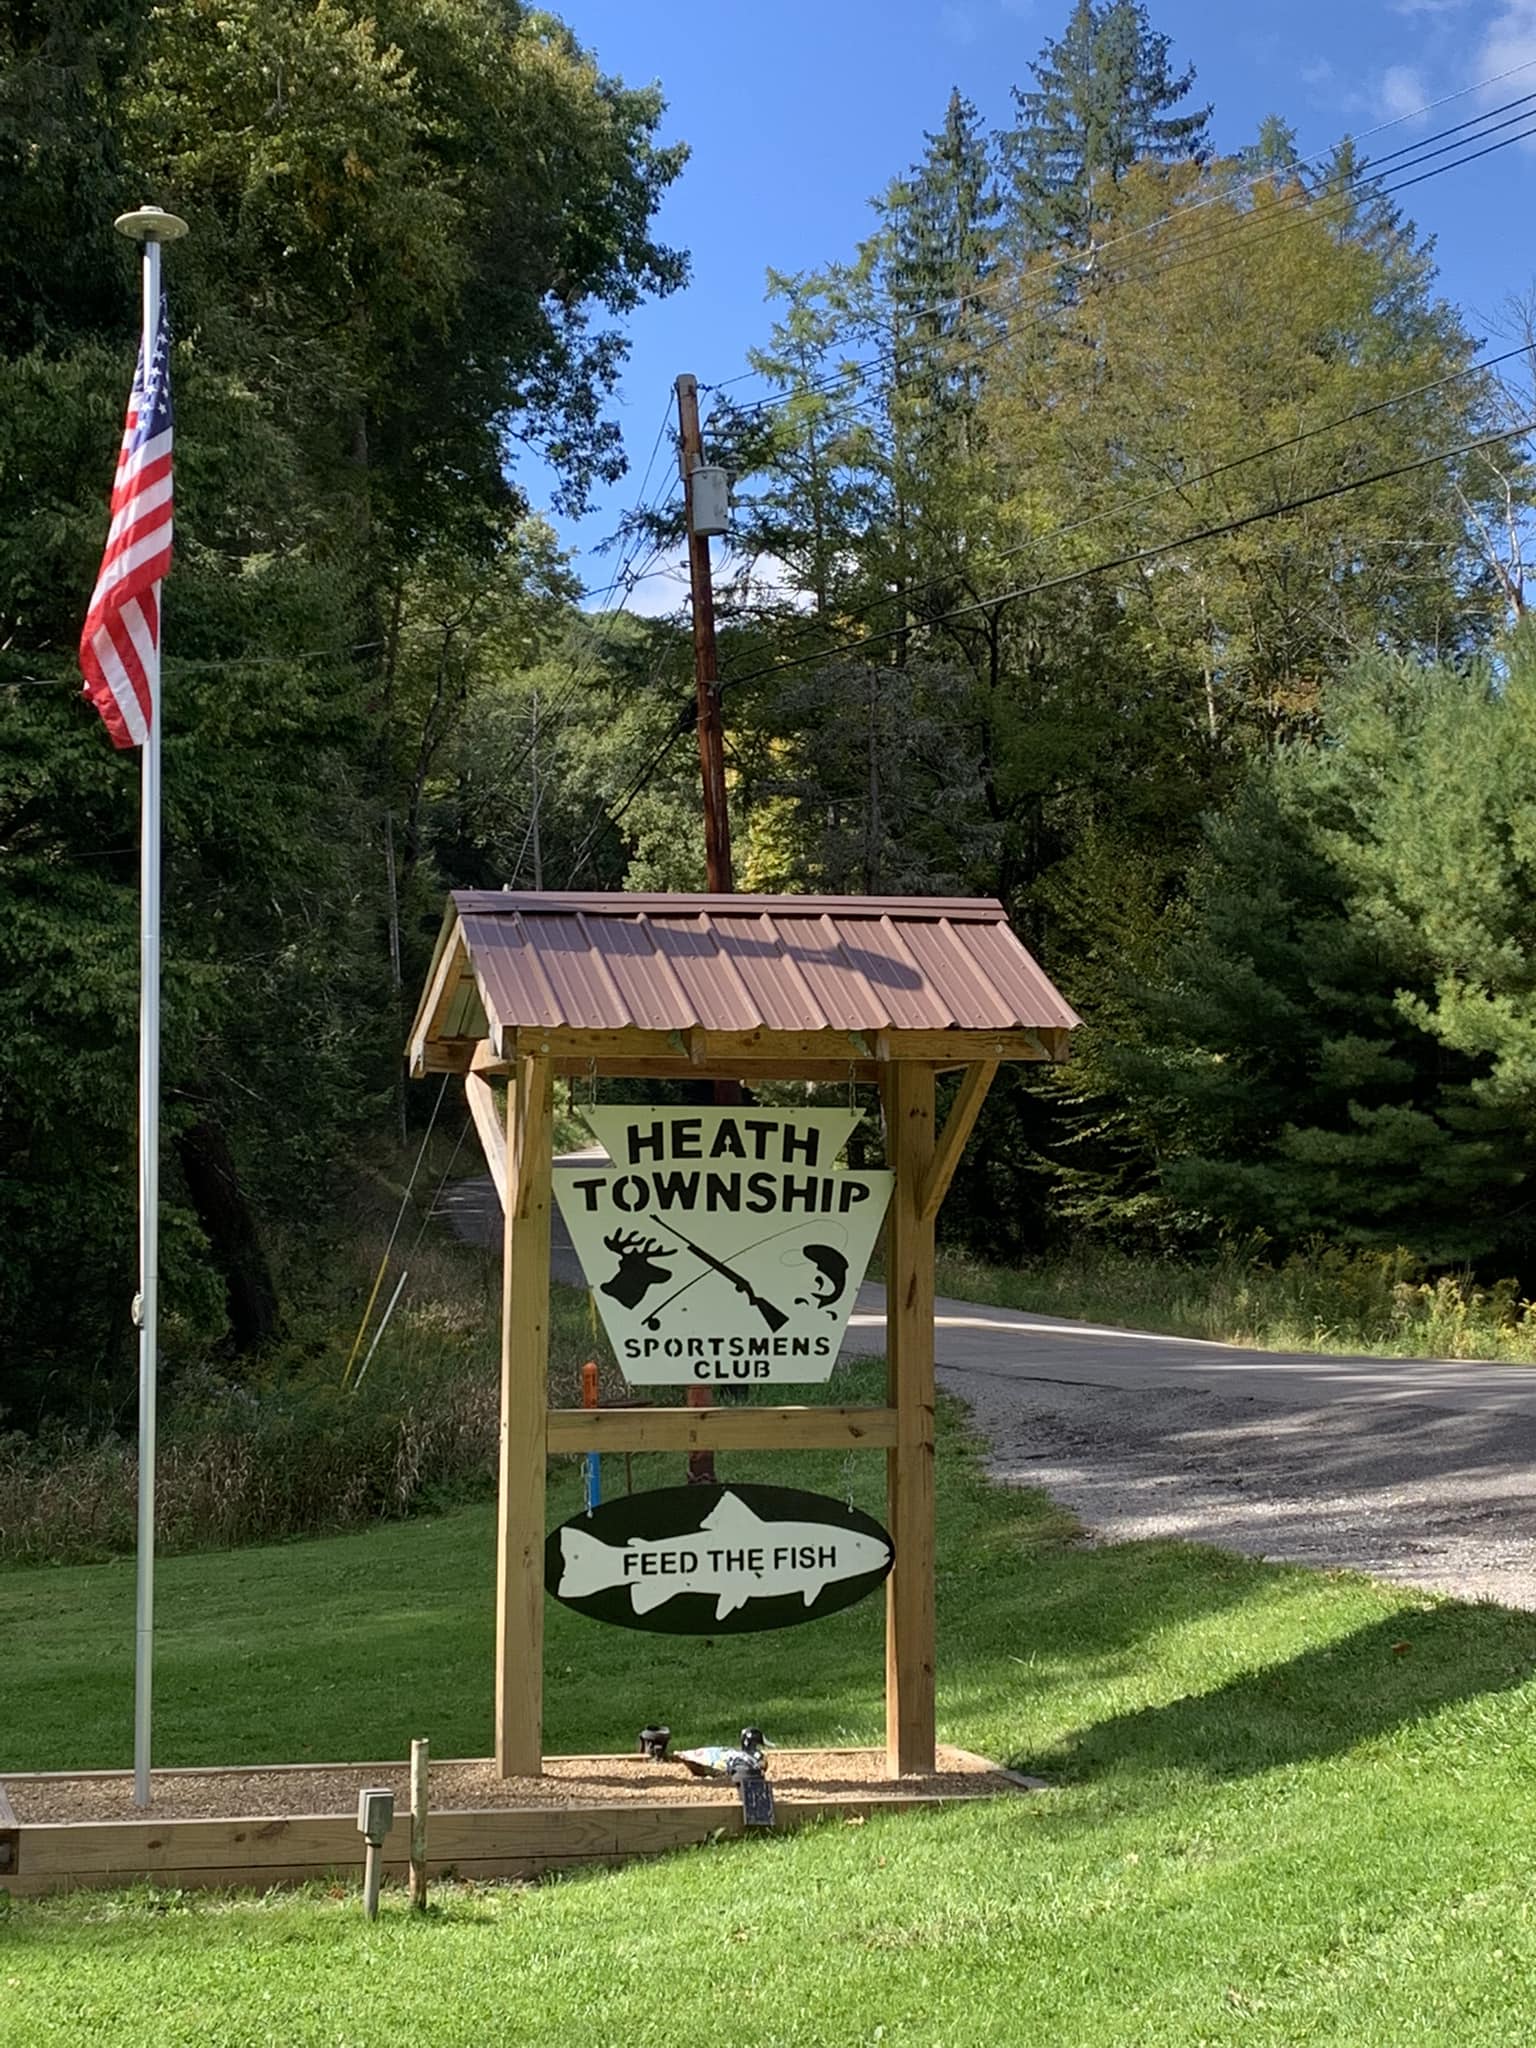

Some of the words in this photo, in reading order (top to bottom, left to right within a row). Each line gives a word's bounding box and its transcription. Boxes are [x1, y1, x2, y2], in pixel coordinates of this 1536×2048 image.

[627, 1118, 819, 1167] HEATH
[573, 1171, 870, 1213] TOWNSHIP
[625, 1337, 830, 1358] SPORTSMENS
[694, 1360, 770, 1378] CLUB
[623, 1552, 698, 1575] FEED
[707, 1549, 764, 1571] THE
[774, 1546, 836, 1569] FISH
